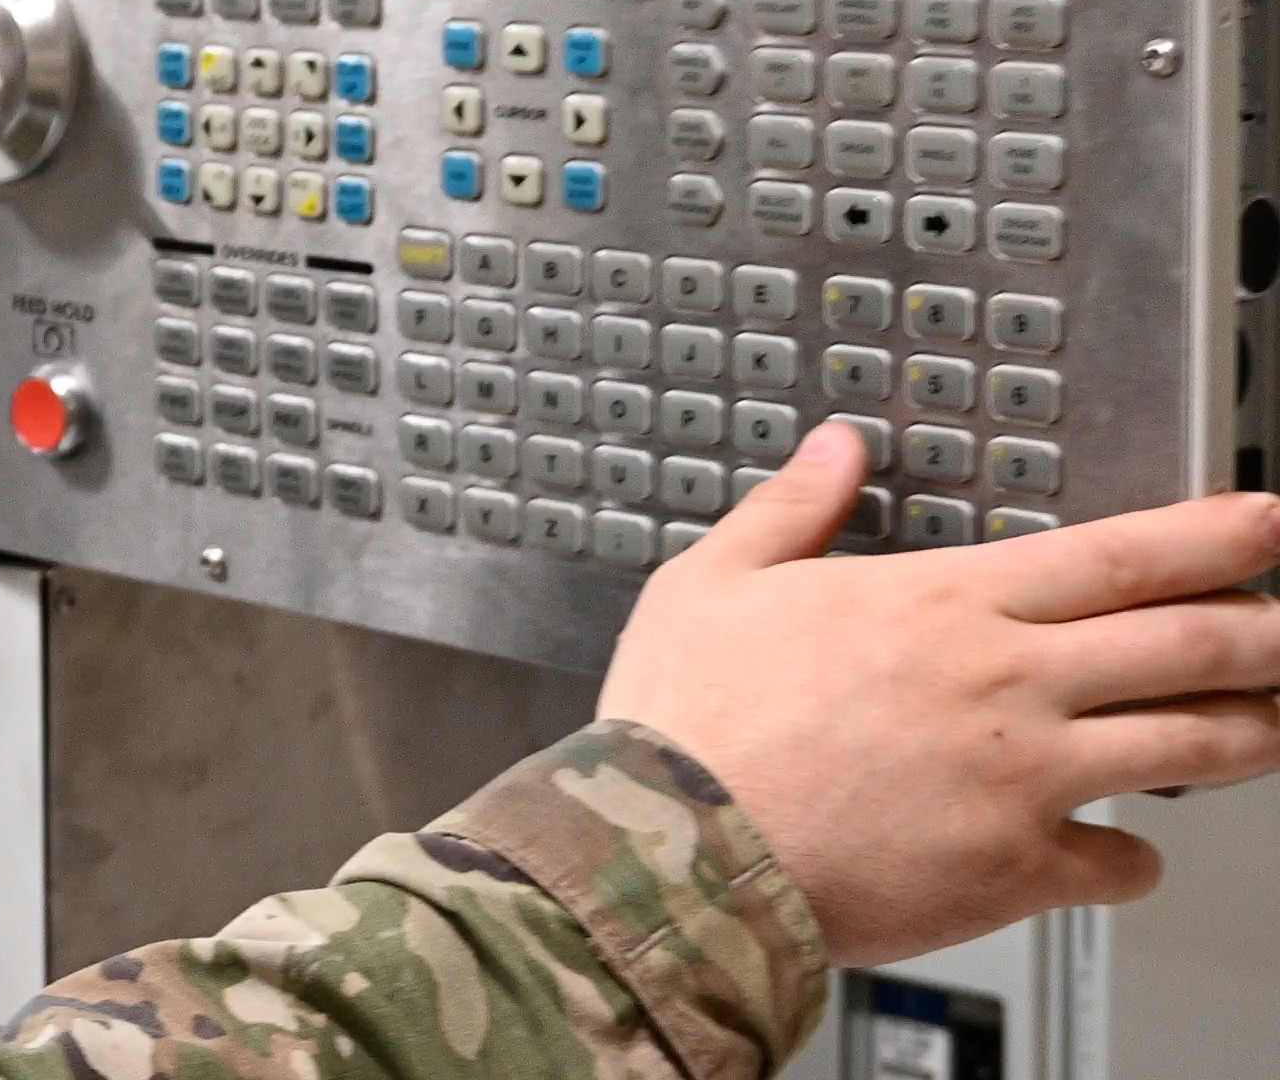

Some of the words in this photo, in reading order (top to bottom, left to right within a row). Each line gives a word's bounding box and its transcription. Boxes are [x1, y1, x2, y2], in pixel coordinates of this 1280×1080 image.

[478, 255, 491, 271] A
[543, 261, 558, 280] B
[610, 268, 626, 289] C
[681, 276, 697, 296] D
[754, 284, 768, 304] E
[12, 295, 47, 316] FEED
[52, 301, 96, 323] HOLD
[848, 295, 862, 315] 7
[614, 335, 623, 353] I
[684, 345, 696, 363] J
[753, 353, 768, 370] K
[416, 372, 426, 389] L
[928, 375, 944, 395] 5
[543, 391, 559, 409] N
[610, 399, 627, 420] O
[681, 409, 696, 427] P
[754, 419, 770, 440] Q
[415, 434, 428, 452] R
[479, 444, 493, 464] S
[545, 454, 557, 473] T
[927, 445, 941, 466] 2
[612, 467, 626, 485] U
[1011, 457, 1027, 479] 3
[683, 479, 695, 496] V
[545, 519, 558, 538] Z
